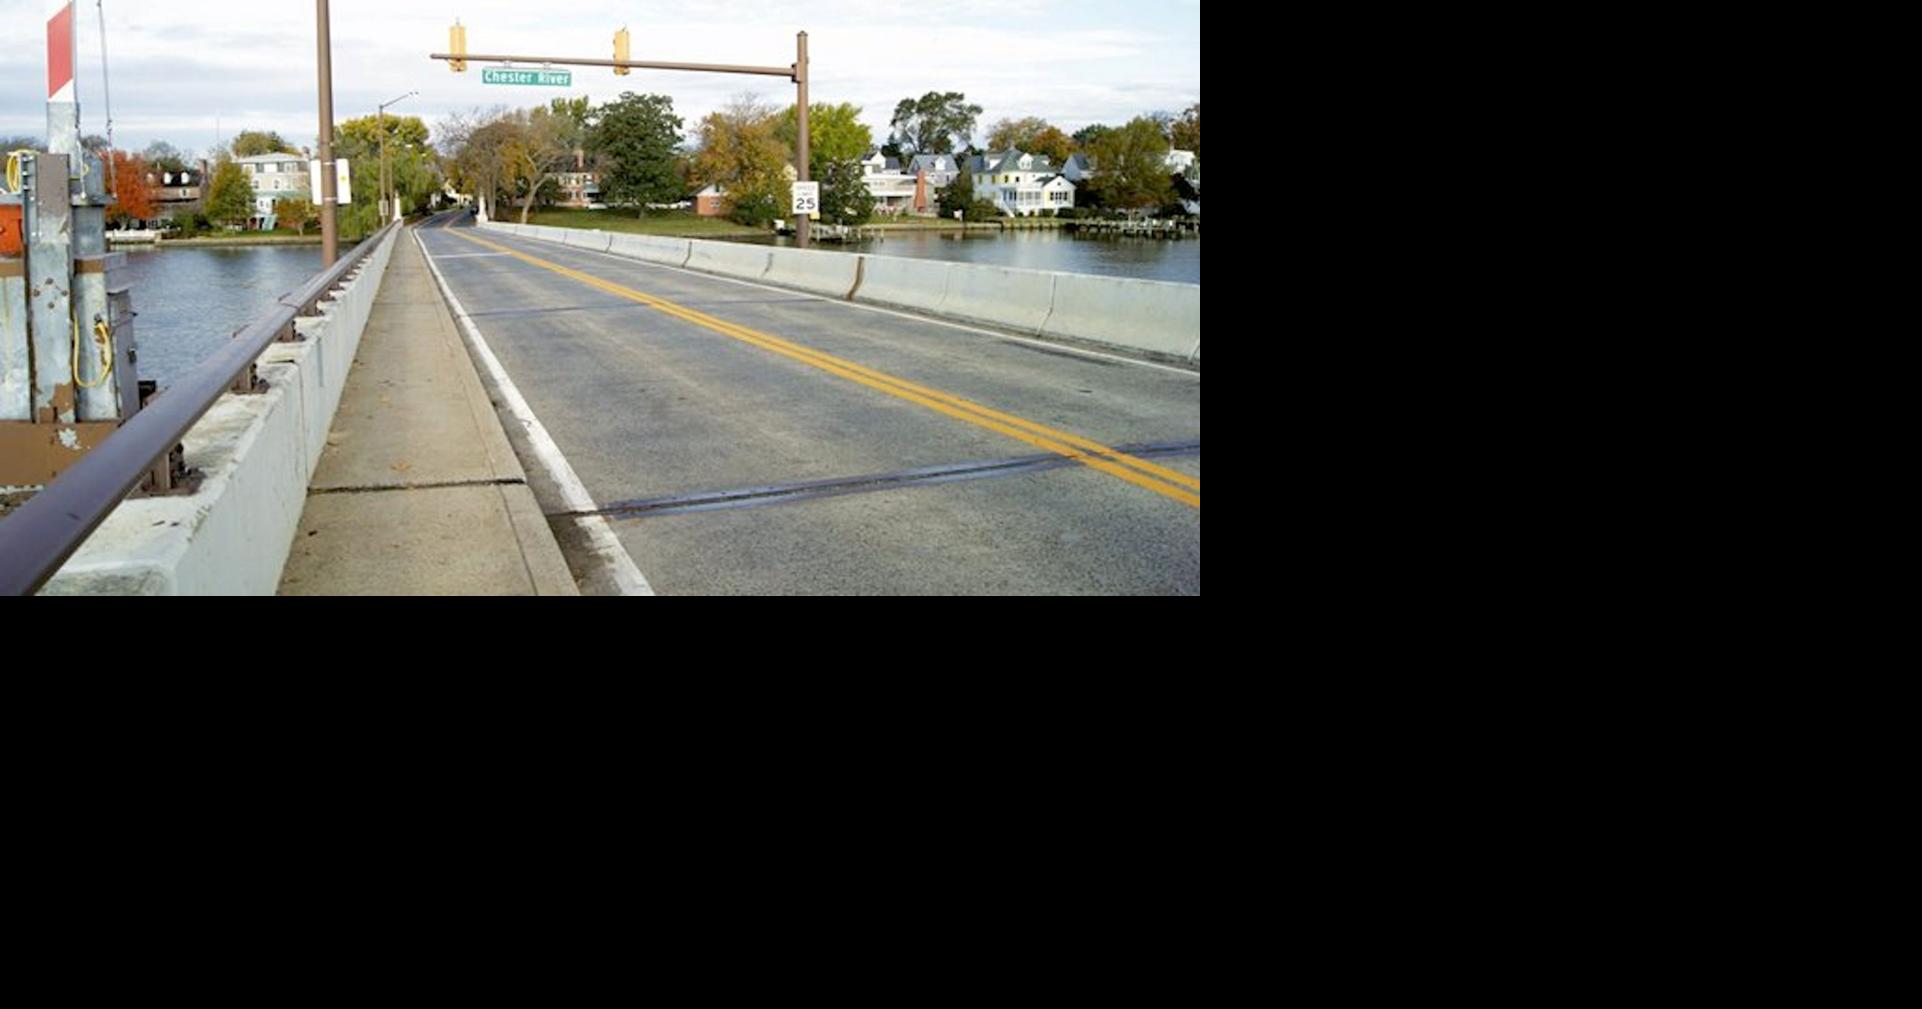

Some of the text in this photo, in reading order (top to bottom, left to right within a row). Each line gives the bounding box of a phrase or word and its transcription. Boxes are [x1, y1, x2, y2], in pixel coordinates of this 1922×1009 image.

[484, 69, 569, 85] Chester River
[796, 197, 816, 210] 25
